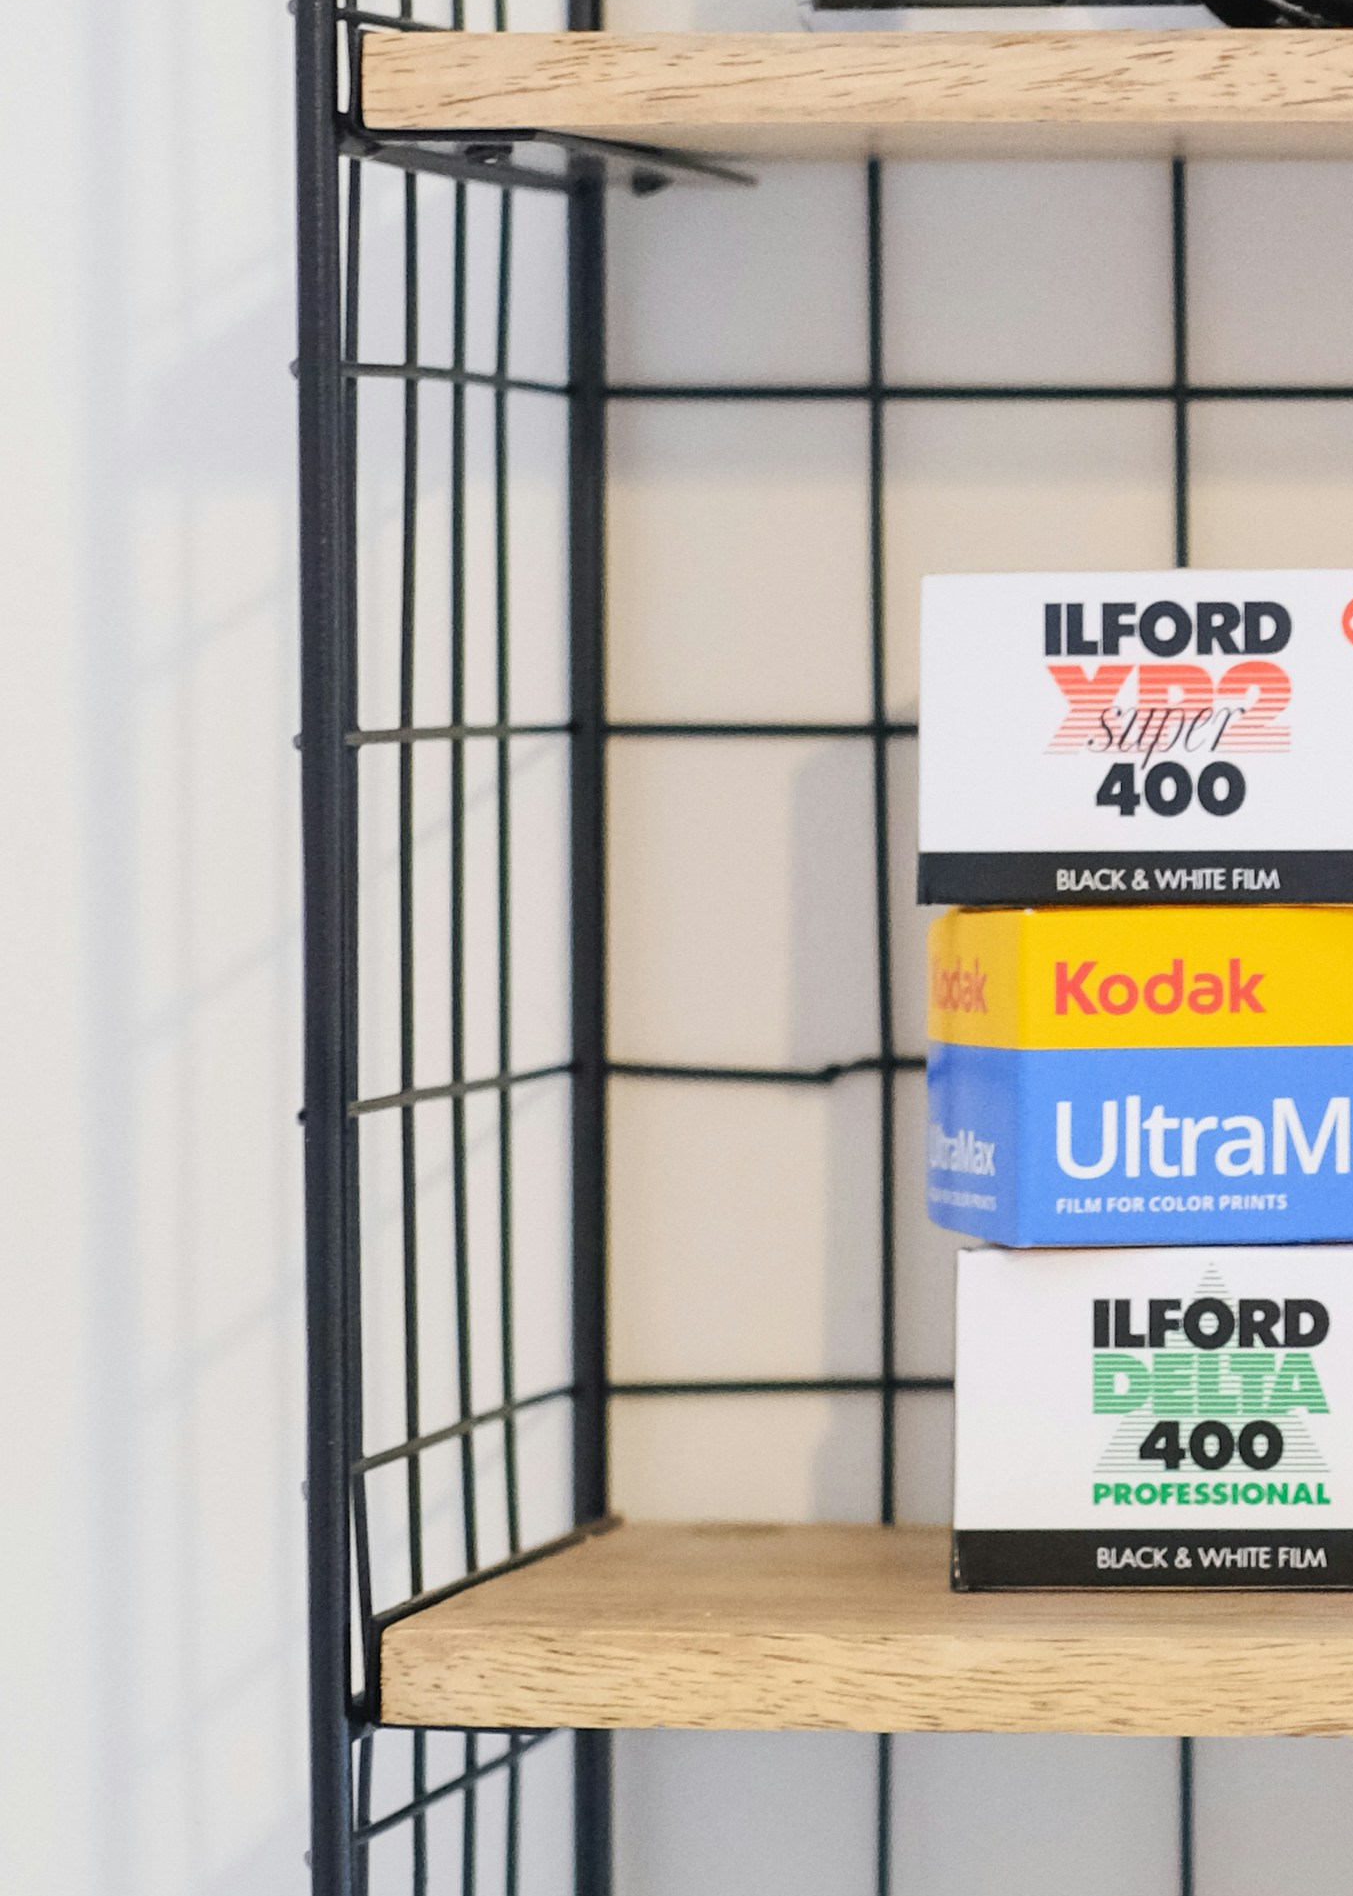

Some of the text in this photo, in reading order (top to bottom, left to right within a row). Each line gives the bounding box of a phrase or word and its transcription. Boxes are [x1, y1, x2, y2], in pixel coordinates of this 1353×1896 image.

[1044, 600, 1293, 657] ILFORD
[1043, 660, 1293, 755] XP2
[1087, 705, 1246, 770] super
[1095, 760, 1247, 817] 400
[1056, 867, 1281, 891] BLACK & WHITE FILM
[1055, 958, 1267, 1016] Kodak
[1056, 1193, 1288, 1214] FILM FOR COLOR PRINTS
[1092, 1297, 1331, 1350] ILFORD
[1092, 1353, 1331, 1415] DELTA
[1138, 1420, 1285, 1471] 400
[1092, 1482, 1332, 1506] PROFESSIONAL
[1096, 1546, 1328, 1570] BLACK & WHITE FILM
